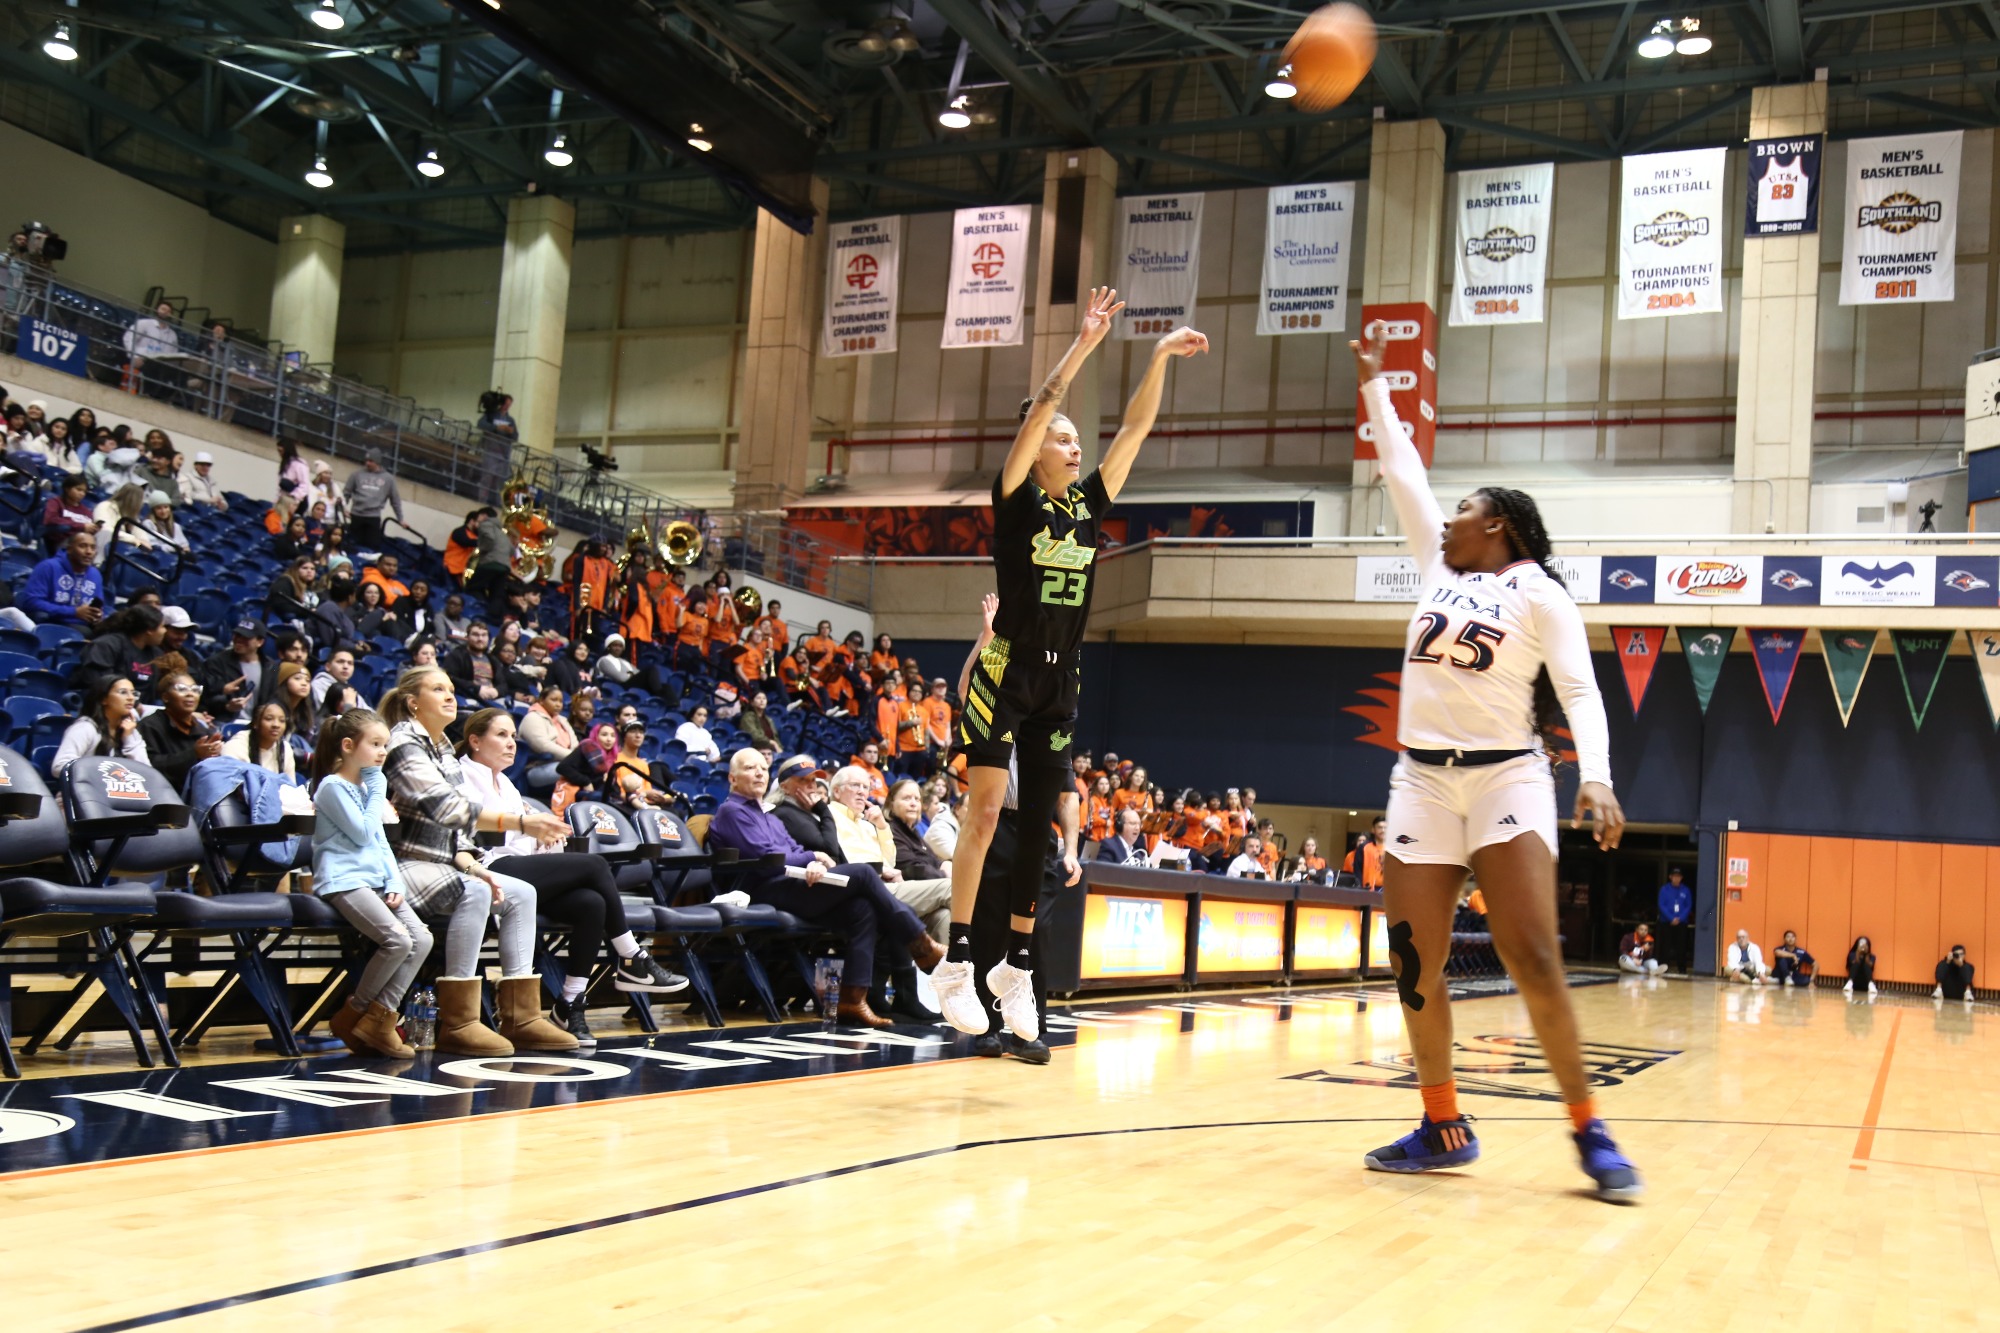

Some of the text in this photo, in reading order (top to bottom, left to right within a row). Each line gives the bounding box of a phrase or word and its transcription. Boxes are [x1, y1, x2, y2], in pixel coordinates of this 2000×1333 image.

[1757, 141, 1814, 157] BROWN
[1882, 150, 1924, 164] MEN'S
[1654, 168, 1692, 180] MEN'S
[1768, 173, 1798, 183] UTSA
[1861, 164, 1944, 179] BASKETBALL
[1294, 188, 1327, 200] MEN'S
[1486, 181, 1522, 194] MEN'S
[1633, 180, 1713, 197] BASKETBALL
[1147, 199, 1178, 209] MEN'S
[1276, 201, 1344, 215] BASKETBALL
[1466, 194, 1541, 210] BASKETBALL
[978, 212, 1005, 221] MEN'S
[1130, 211, 1193, 224] BASKETBALL
[1859, 201, 1941, 227] SOUTHLAND
[851, 223, 878, 234] MEN'S
[964, 223, 1020, 236] BASKETBALL
[1634, 217, 1709, 243] SOUTHLAND
[837, 234, 891, 248] BASKETBALL
[1466, 235, 1534, 256] SOUTHLAND
[1274, 242, 1339, 258] Southland
[1128, 251, 1189, 266] Southland
[1289, 256, 1336, 266] Conference
[1858, 252, 1938, 265] TOURNAMENT
[1142, 264, 1186, 273] Conference
[1632, 263, 1714, 279] TOURNAMENT
[1861, 264, 1932, 278] CHAMPIONS
[1464, 284, 1534, 297] CHAMPIONS
[1634, 276, 1710, 292] CHAMPIONS
[1875, 280, 1916, 299] 2011
[1268, 286, 1339, 298] TOURNAMENT
[1269, 300, 1335, 312] CHAMPIONS
[1475, 300, 1519, 315] 2004
[1647, 292, 1696, 310] 2004
[832, 311, 890, 325] TOURNAMENT
[1124, 306, 1184, 318] CHAMPIONS
[955, 316, 1012, 327] CHAMPIONS
[33, 320, 78, 342] SECTION
[833, 324, 887, 337] CHAMPIONS
[31, 331, 77, 361] 107
[1031, 525, 1097, 571] USF
[1670, 563, 1747, 595] Cane's
[1041, 570, 1087, 607] 23
[1431, 587, 1501, 621] UTSA
[1408, 611, 1507, 673] 25
[108, 780, 144, 793] UTSA
[659, 826, 679, 836] UTSA
[1107, 900, 1164, 947] UTSA
